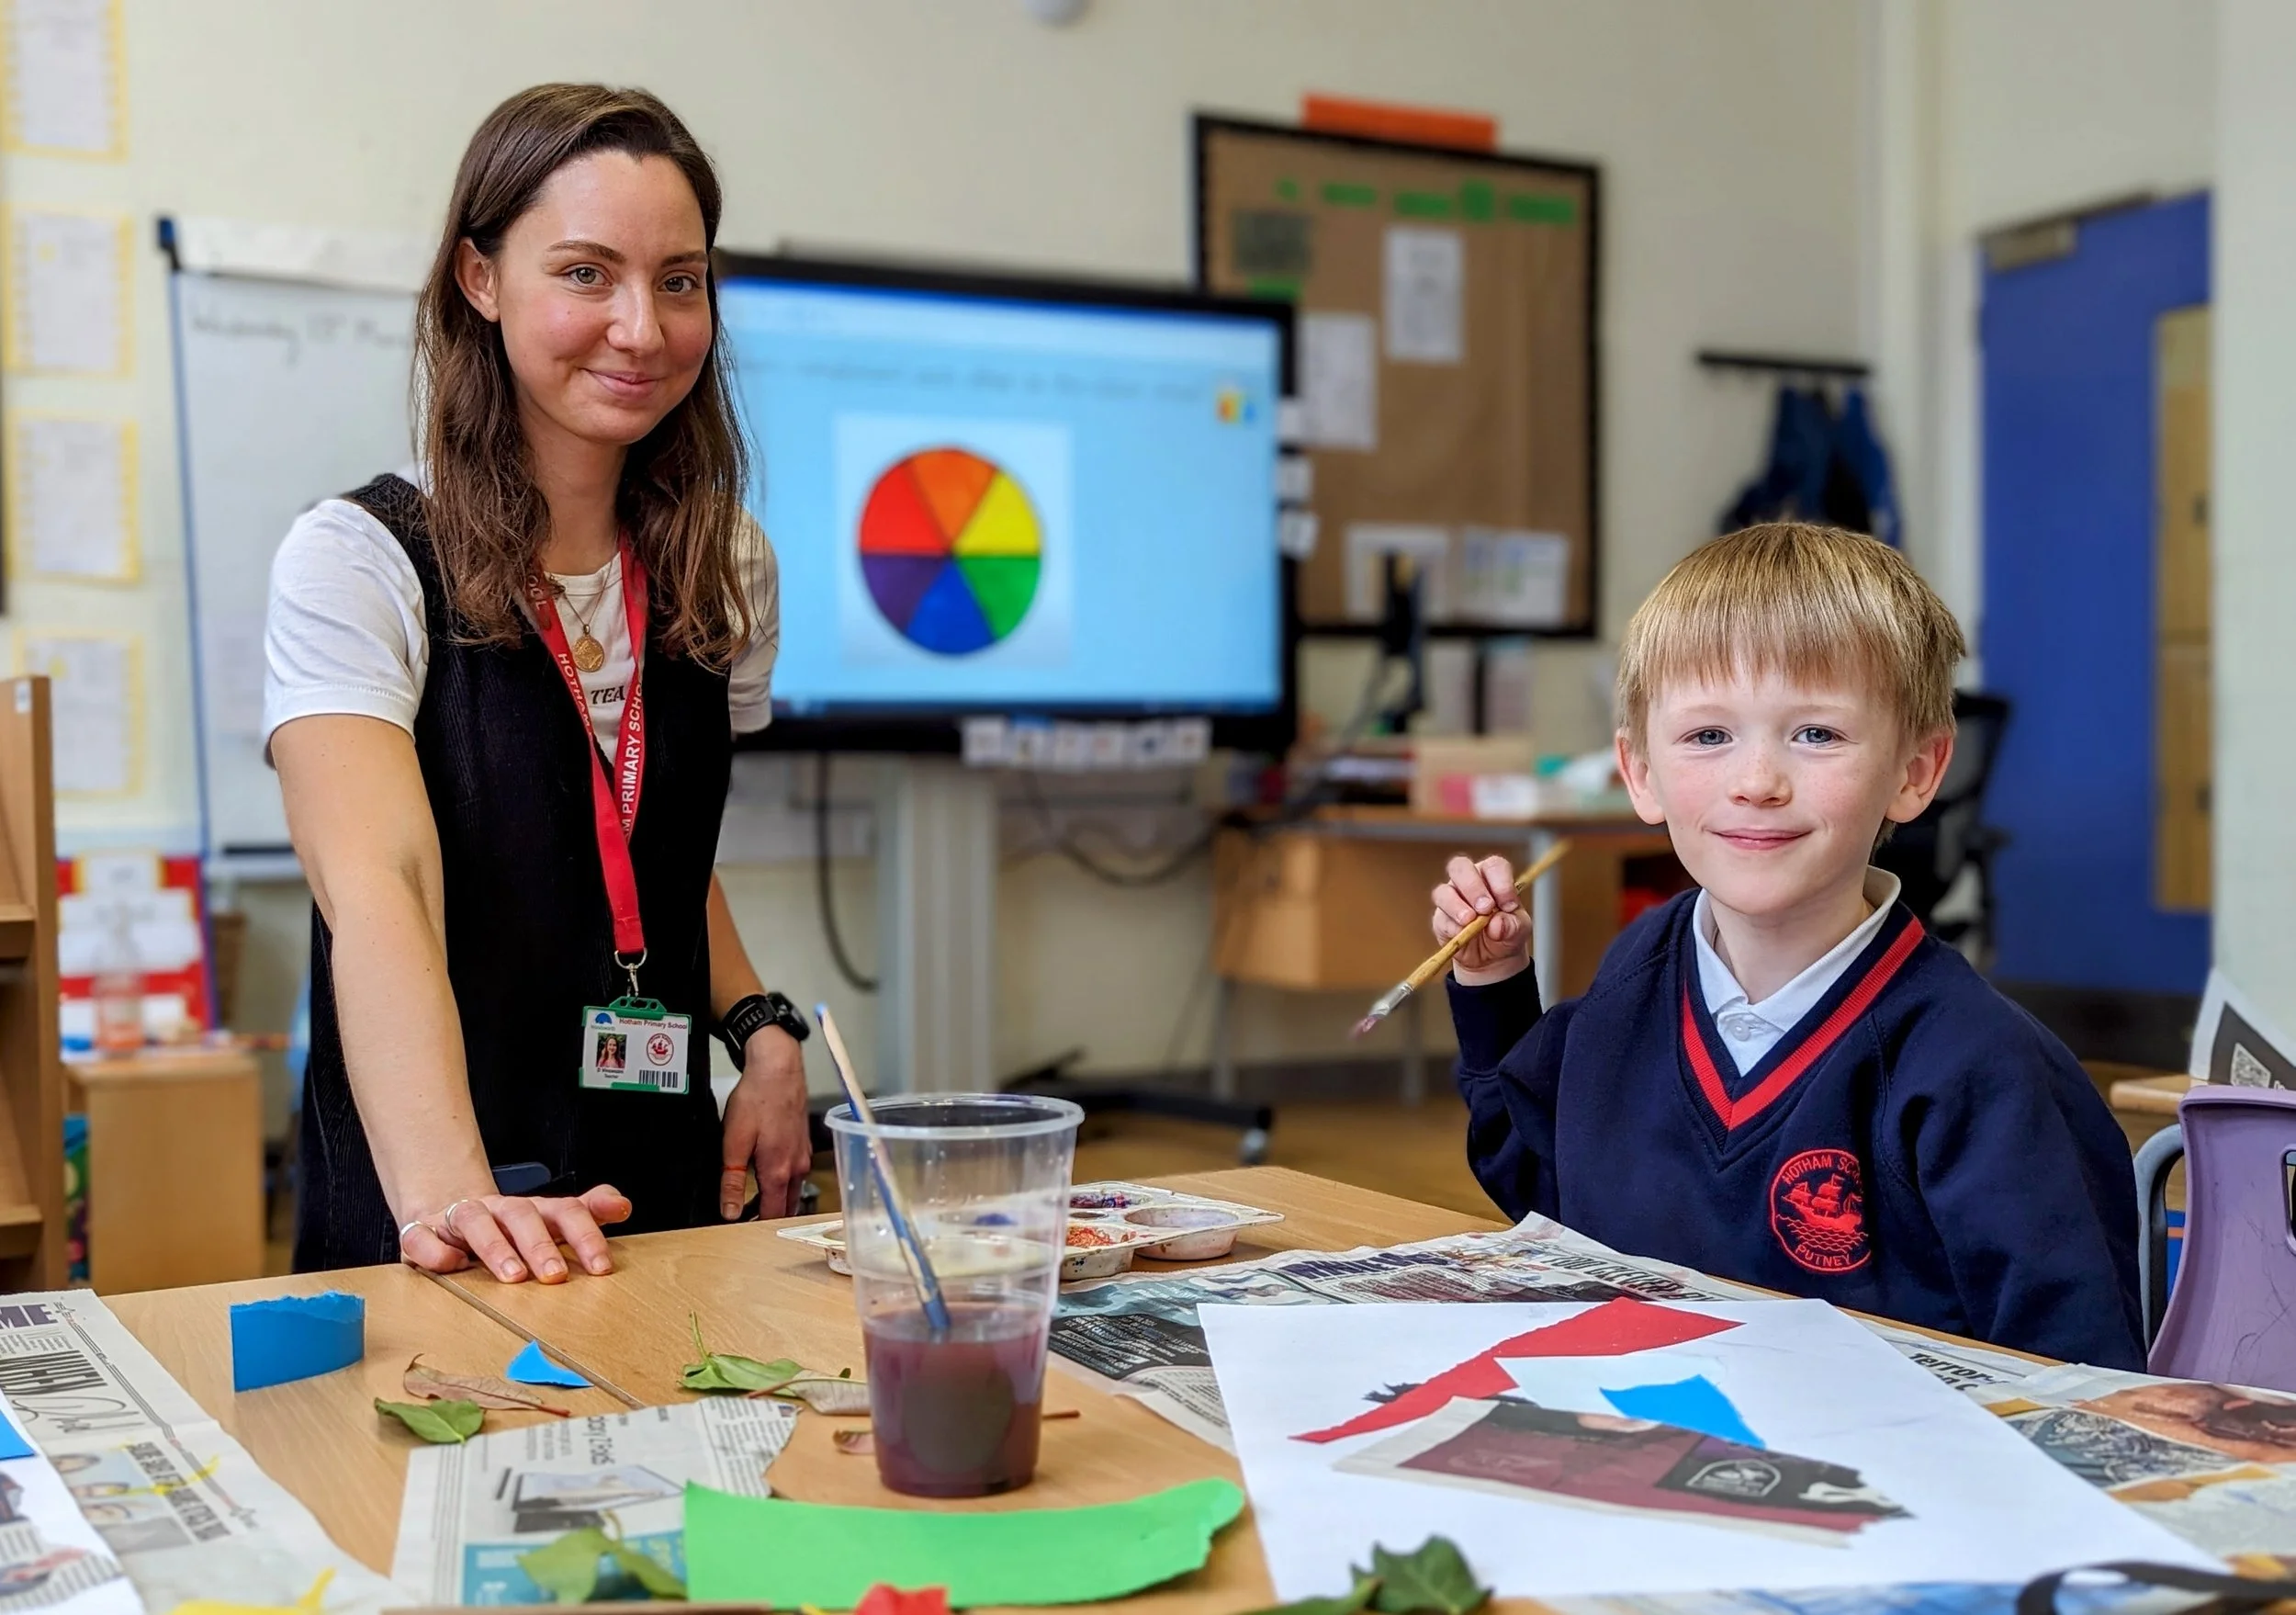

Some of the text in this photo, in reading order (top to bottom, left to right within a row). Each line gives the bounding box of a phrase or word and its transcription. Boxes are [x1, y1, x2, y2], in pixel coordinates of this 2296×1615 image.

[557, 653, 591, 728] HOTHAM
[591, 685, 625, 705] TEA
[628, 683, 643, 732] SCHO
[622, 734, 641, 814] PRIMARY
[619, 1018, 688, 1030] Hotham Primary School
[1782, 1155, 1833, 1185] HOTHAM
[1795, 1244, 1851, 1267] PUTNEY
